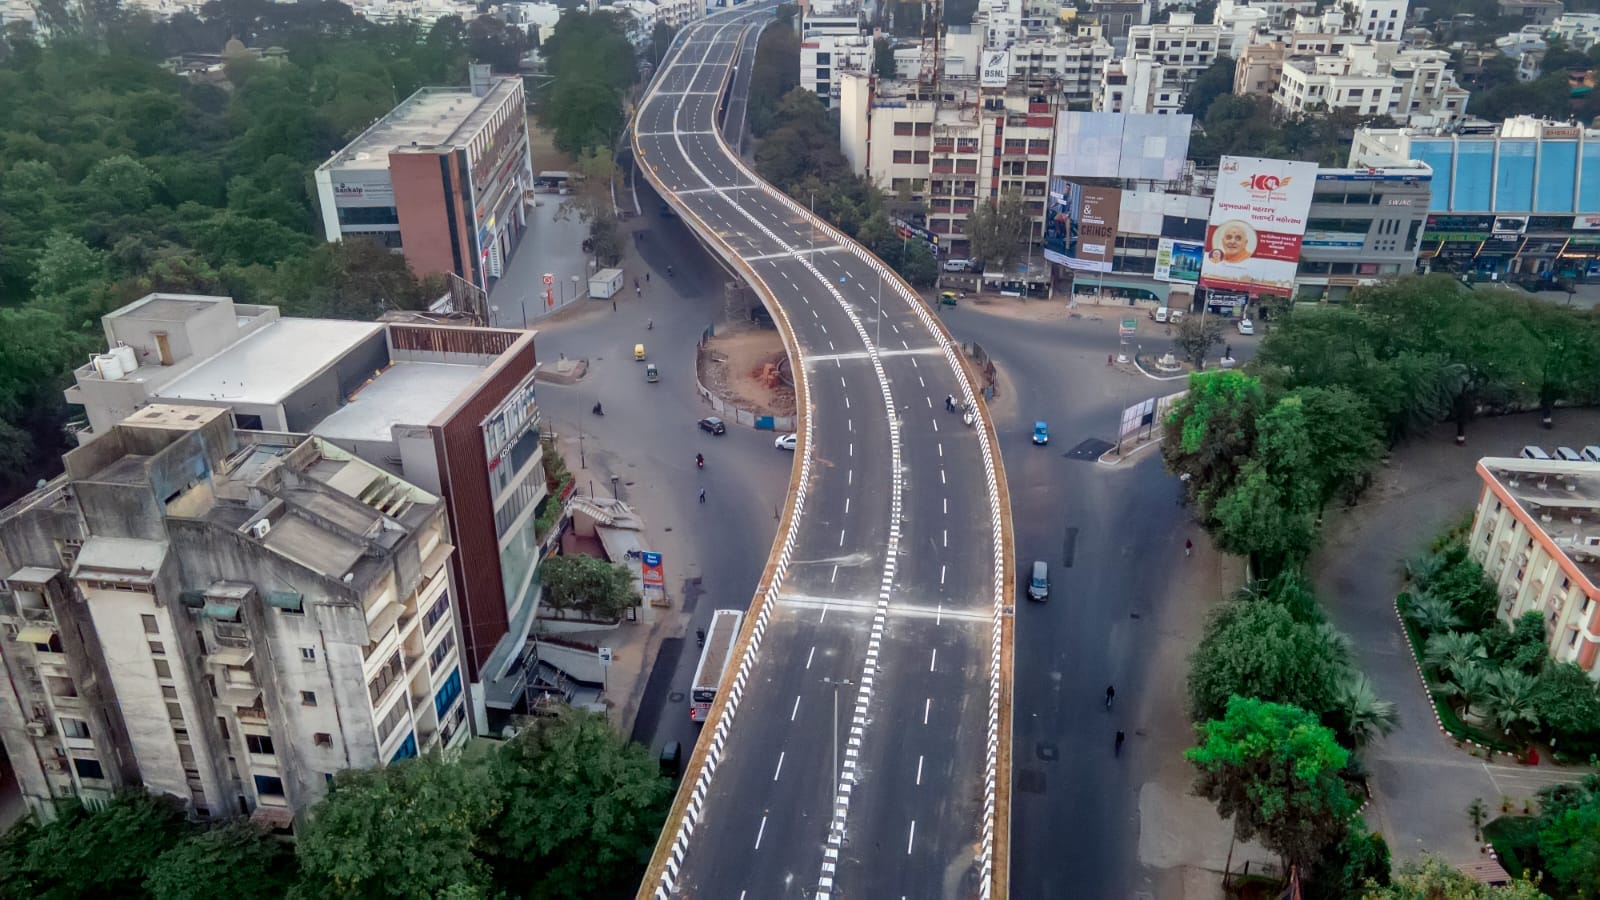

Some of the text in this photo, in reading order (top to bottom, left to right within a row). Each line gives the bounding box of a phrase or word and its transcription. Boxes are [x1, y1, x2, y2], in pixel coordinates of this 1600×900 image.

[984, 70, 1005, 78] BSNL
[335, 186, 363, 194] Sankalp
[1080, 225, 1113, 238] CHINOS
